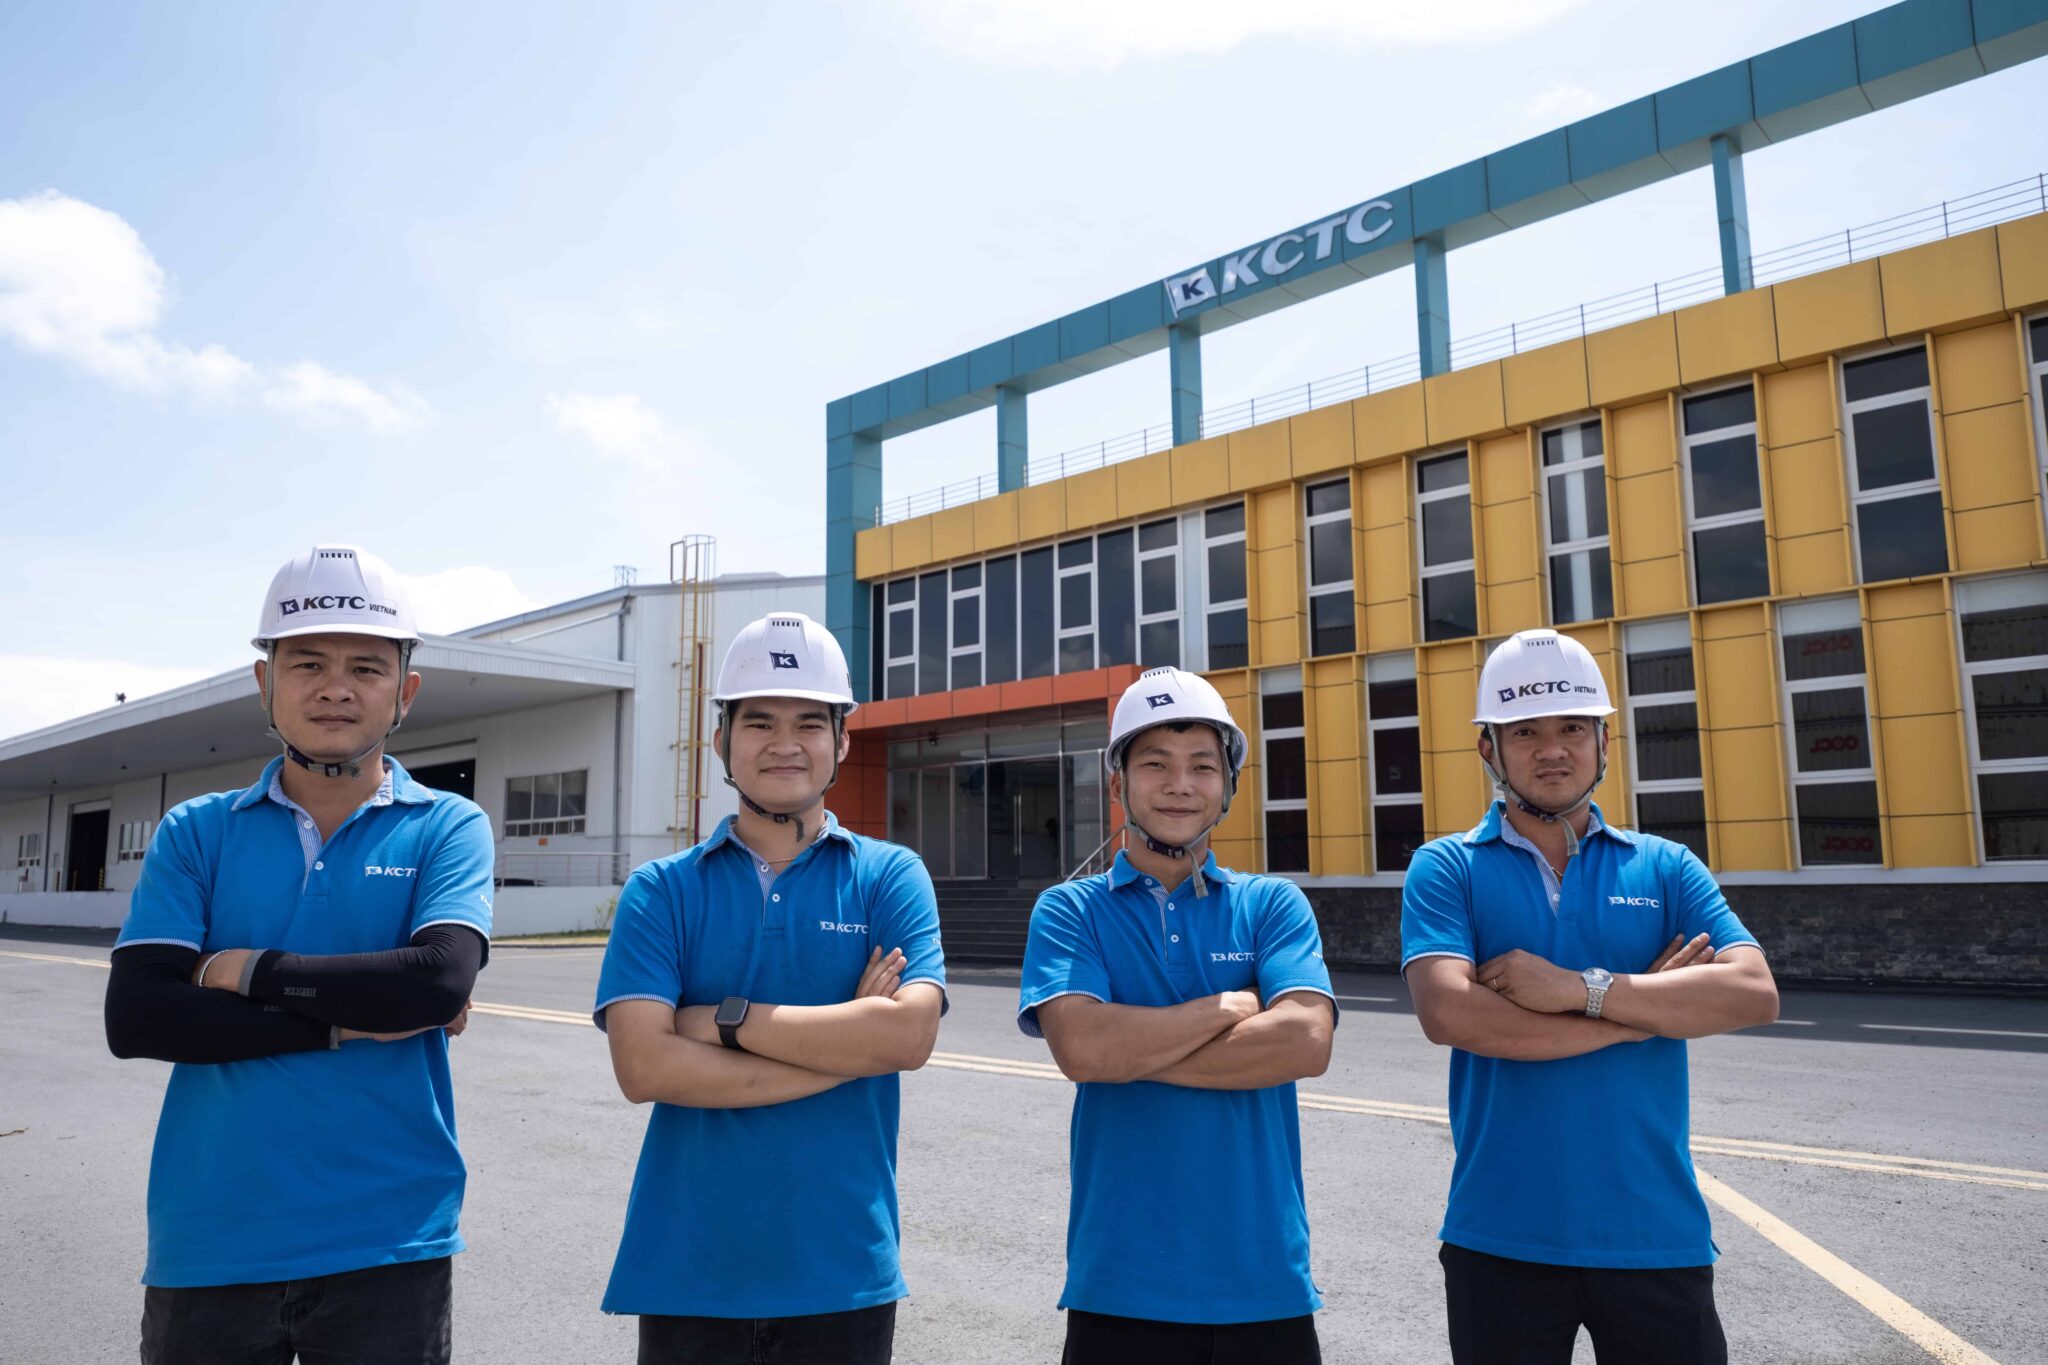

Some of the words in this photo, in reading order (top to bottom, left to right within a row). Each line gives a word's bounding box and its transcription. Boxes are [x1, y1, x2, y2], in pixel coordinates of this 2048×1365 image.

[1221, 201, 1394, 295] KCTC
[303, 595, 366, 611] KCTC
[369, 603, 398, 616] VIETNAM
[1518, 680, 1571, 697] KCTC
[1574, 685, 1597, 694] VIETNAM
[1627, 896, 1660, 908] KCTC
[836, 922, 869, 934] KCTC
